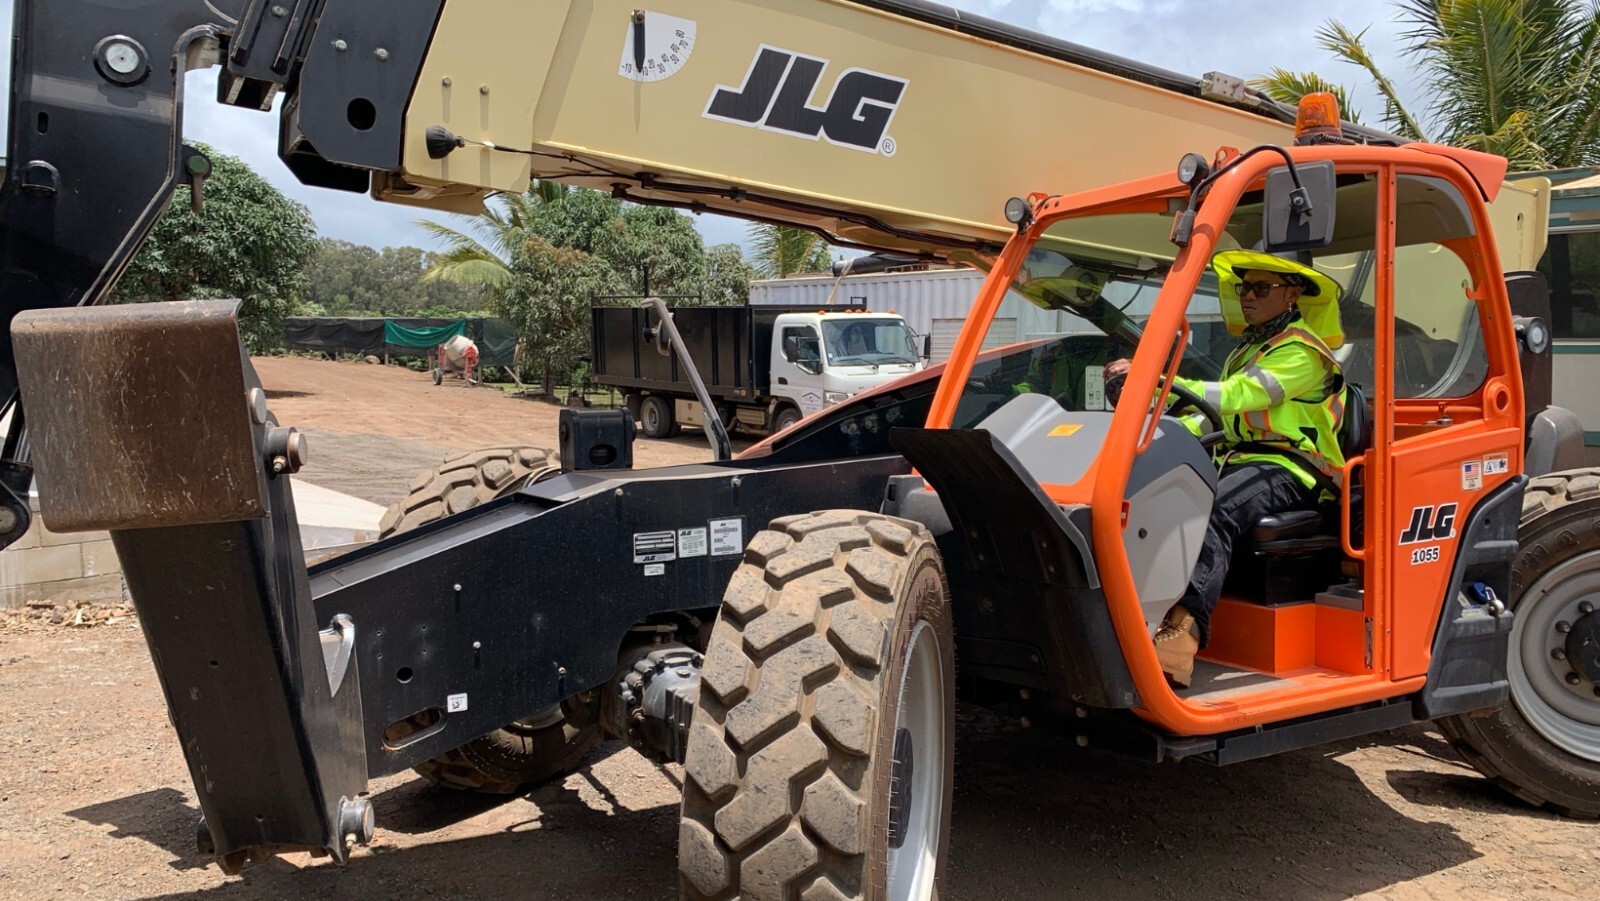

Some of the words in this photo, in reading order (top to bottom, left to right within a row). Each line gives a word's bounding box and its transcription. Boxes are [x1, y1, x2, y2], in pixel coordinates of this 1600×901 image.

[648, 58, 656, 69] 20
[703, 45, 908, 152] JLG
[1399, 502, 1458, 544] JLG
[1412, 547, 1440, 564] 1055
